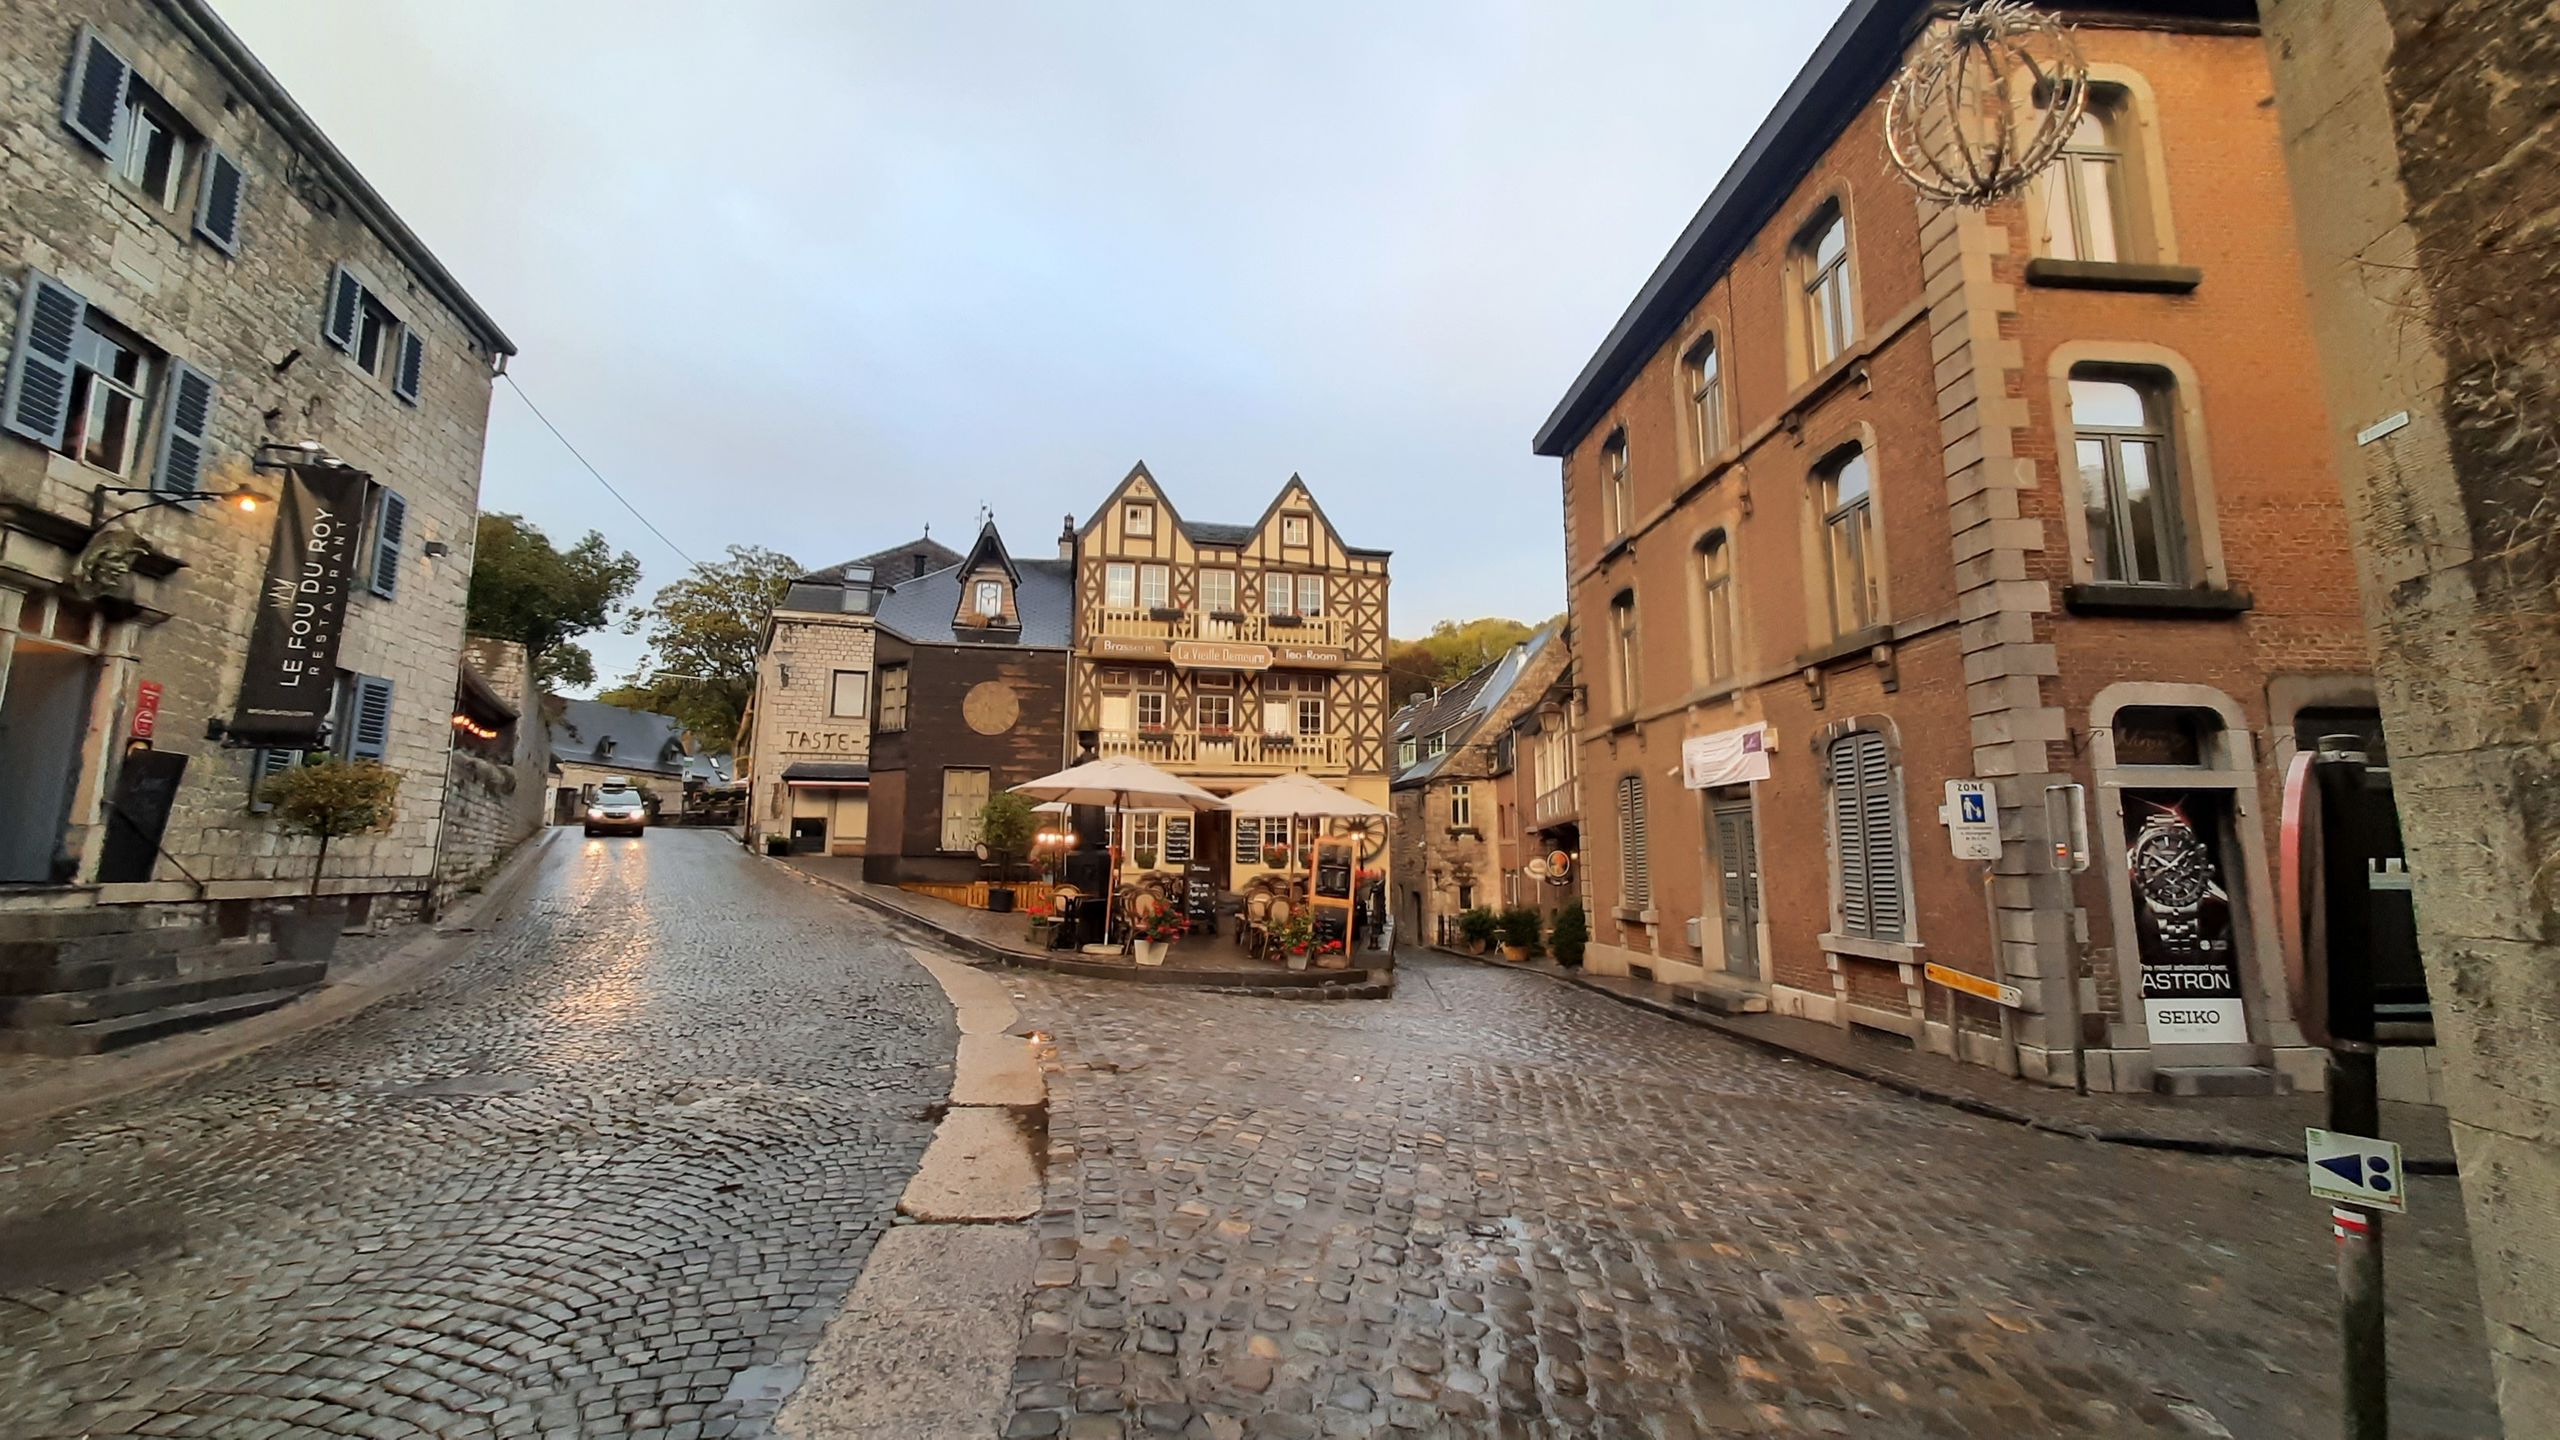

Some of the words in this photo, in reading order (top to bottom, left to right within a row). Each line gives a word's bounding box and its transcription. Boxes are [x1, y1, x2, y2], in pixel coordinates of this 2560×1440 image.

[308, 507, 334, 553] ROY
[300, 562, 324, 594] DU
[308, 521, 347, 675] RESTAURANT
[288, 602, 315, 649] FOU
[1178, 646, 1189, 660] La
[280, 659, 304, 687] LE
[1957, 783, 1985, 792] ZONE
[2143, 973, 2231, 990] ASTRON
[2158, 1010, 2220, 1025] SEIKO
